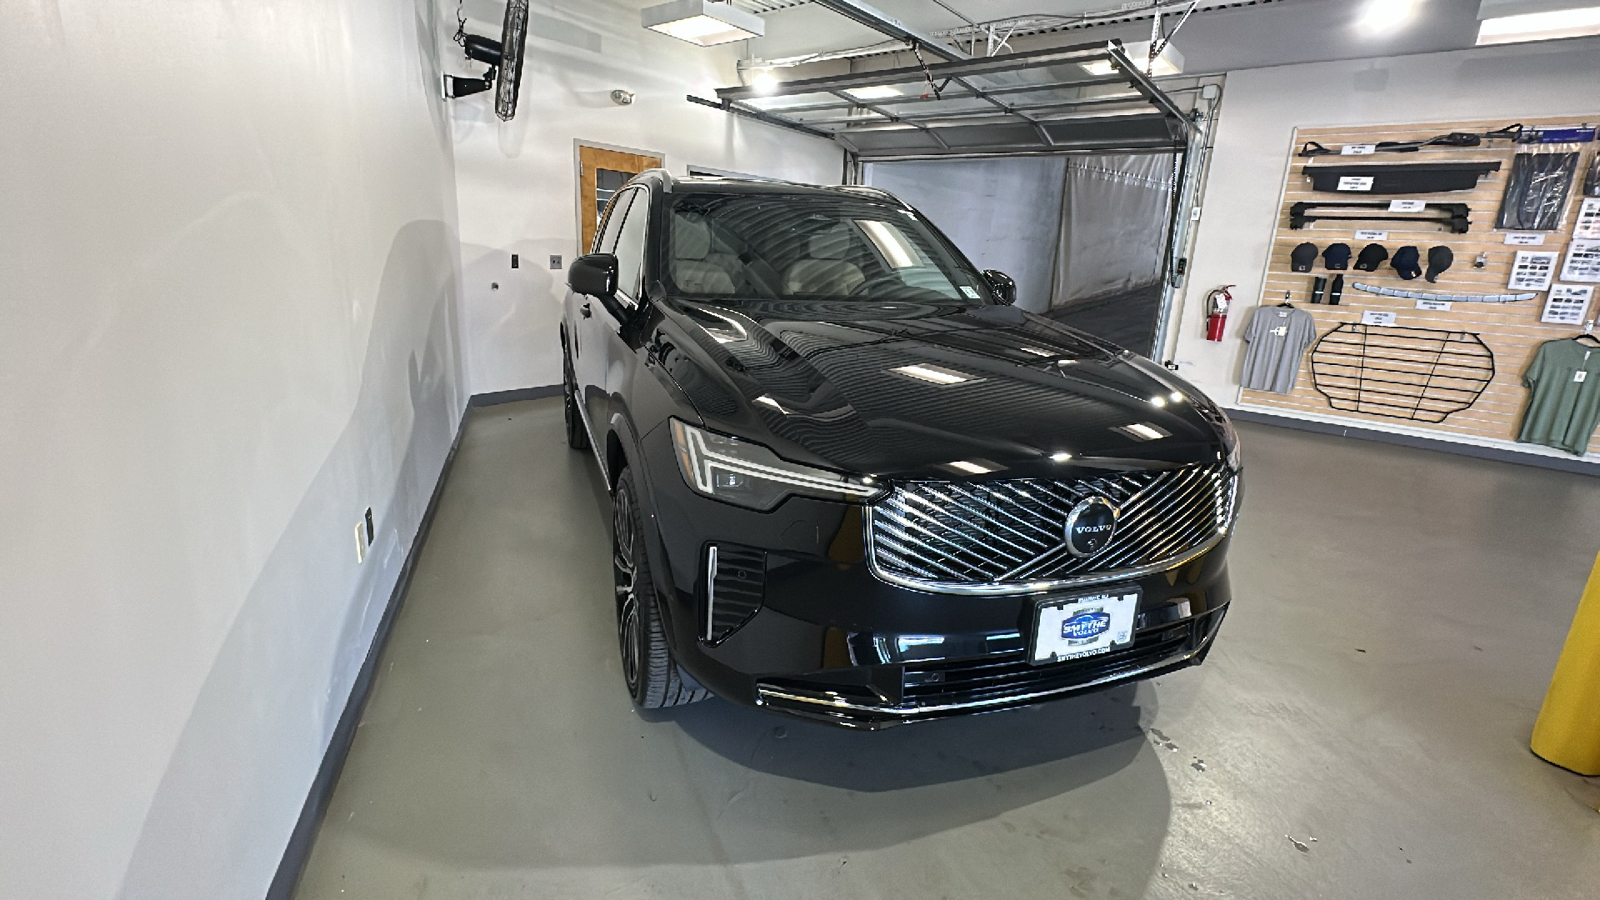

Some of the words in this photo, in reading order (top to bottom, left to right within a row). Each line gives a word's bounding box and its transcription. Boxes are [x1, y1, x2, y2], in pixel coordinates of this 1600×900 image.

[1075, 524, 1112, 534] VOLVO
[1063, 619, 1108, 634] SMYTHE
[1056, 646, 1111, 662] SMYTHEVOLVO.COM
